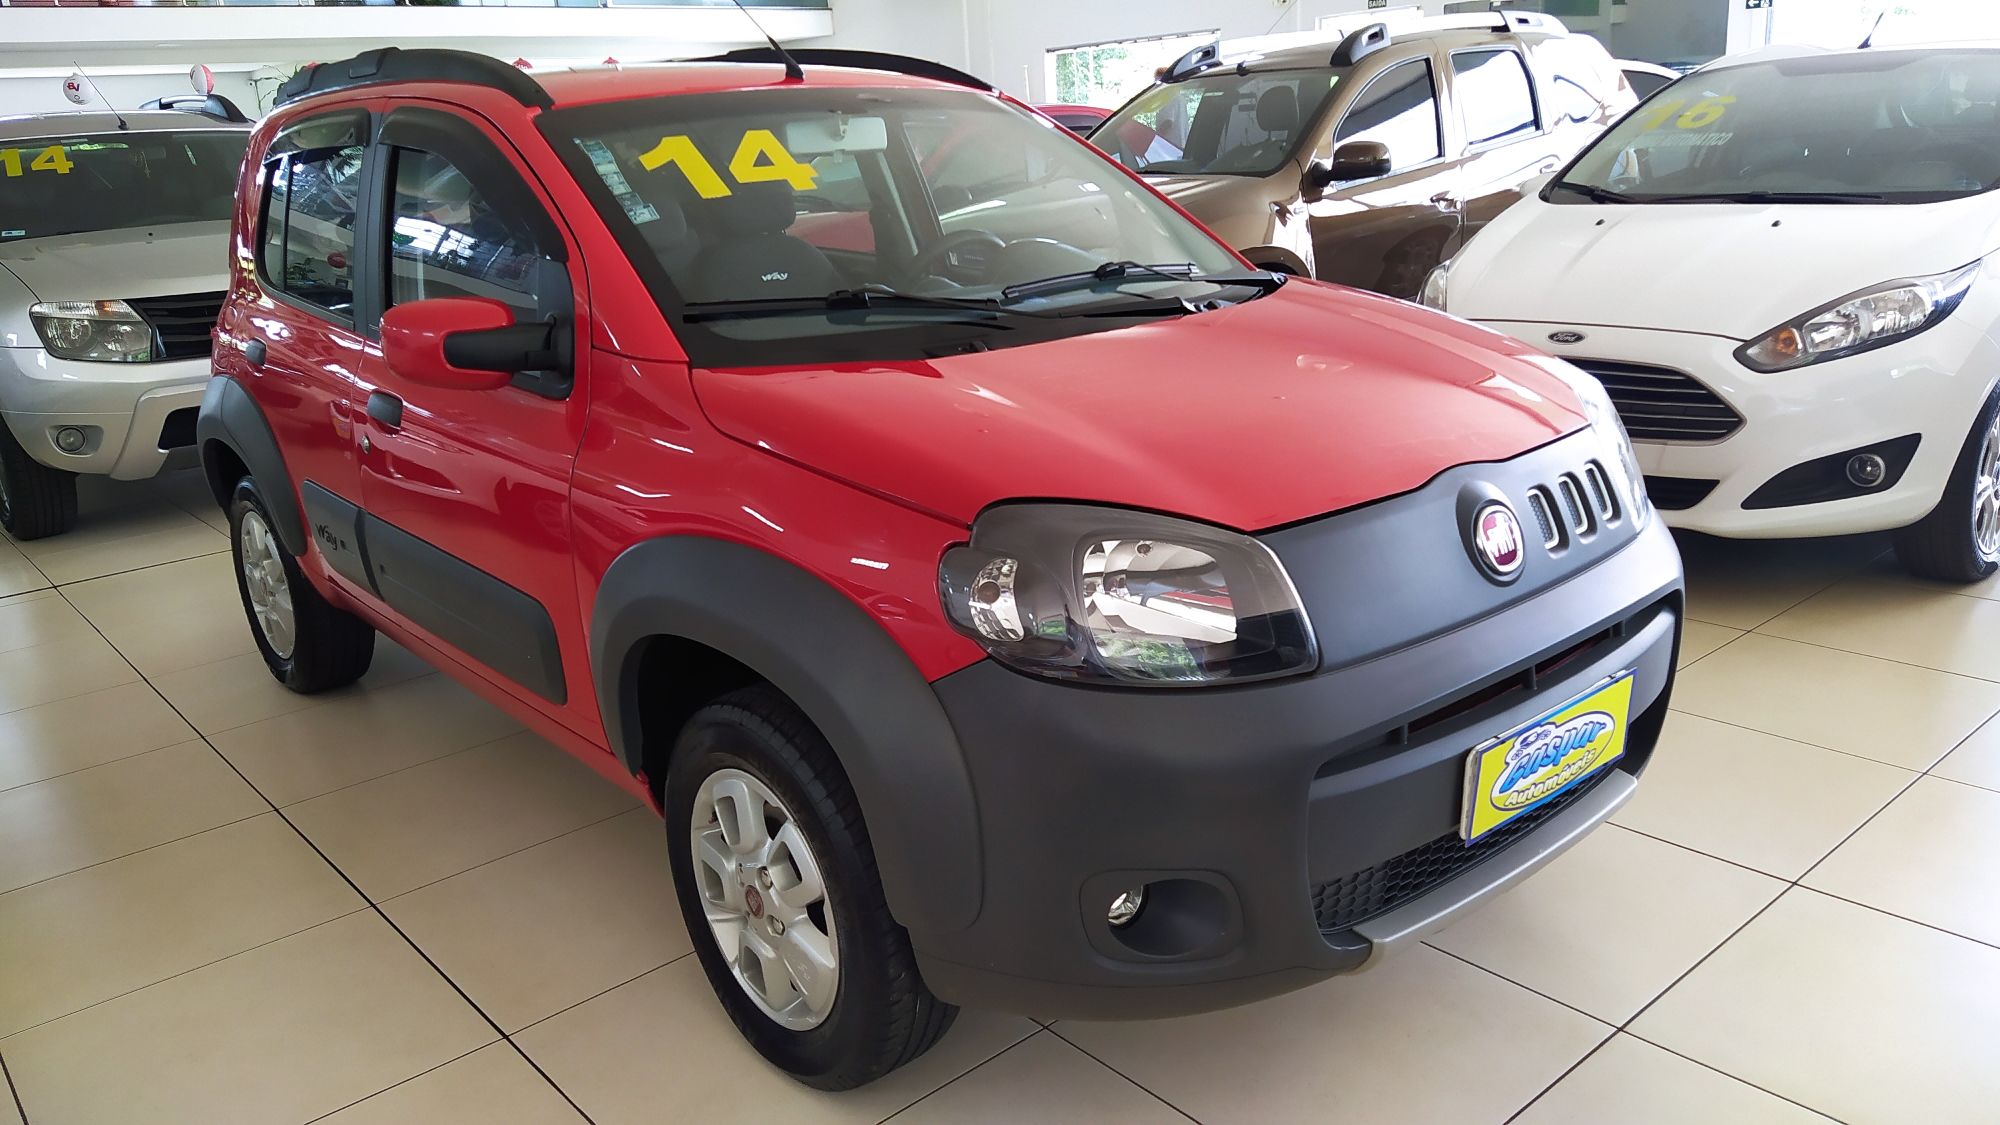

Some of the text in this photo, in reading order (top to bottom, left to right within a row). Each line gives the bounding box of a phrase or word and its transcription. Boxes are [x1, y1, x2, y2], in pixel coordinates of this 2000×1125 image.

[1644, 96, 1737, 131] 16
[0, 145, 74, 176] 14
[638, 129, 818, 199] 14
[1503, 748, 1597, 807] Automóveis
